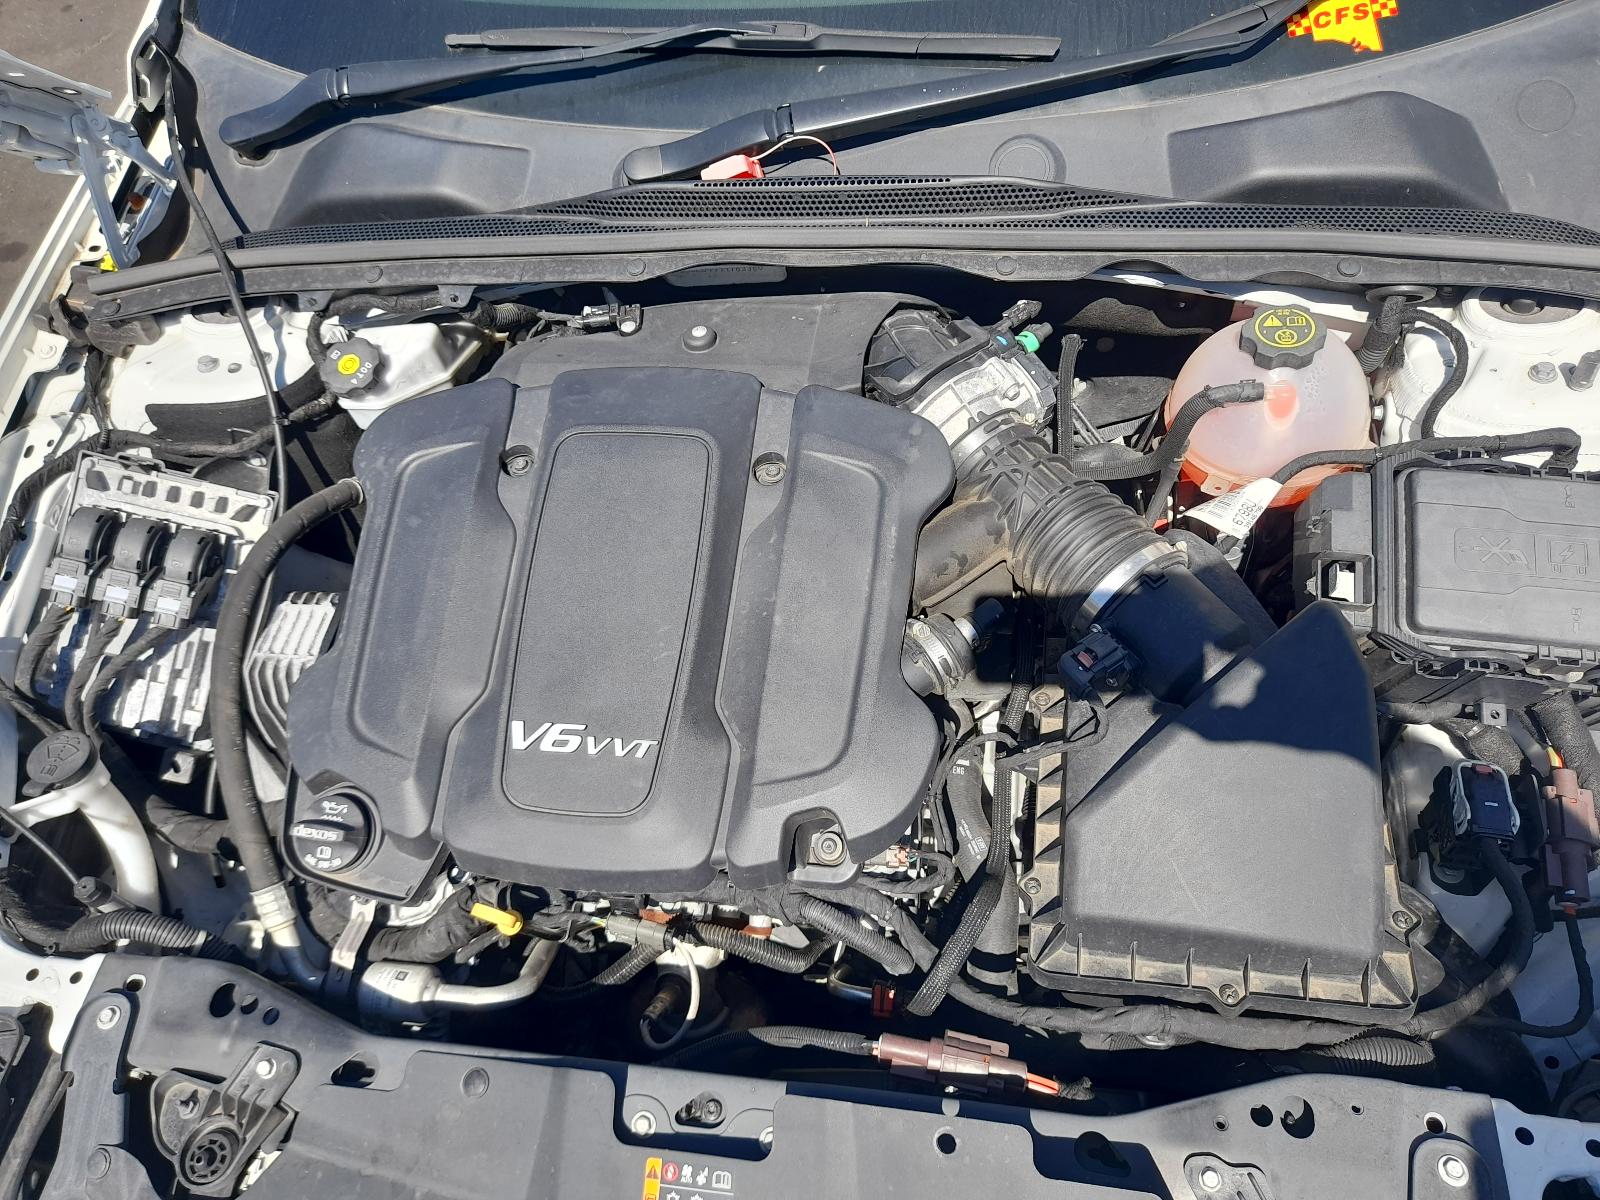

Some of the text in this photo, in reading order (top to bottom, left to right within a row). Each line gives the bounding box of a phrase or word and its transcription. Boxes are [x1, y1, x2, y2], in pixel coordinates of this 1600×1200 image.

[1313, 3, 1370, 29] CFS
[356, 362, 373, 379] DOT
[511, 720, 659, 758] V6 VVT
[952, 765, 965, 775] ENG
